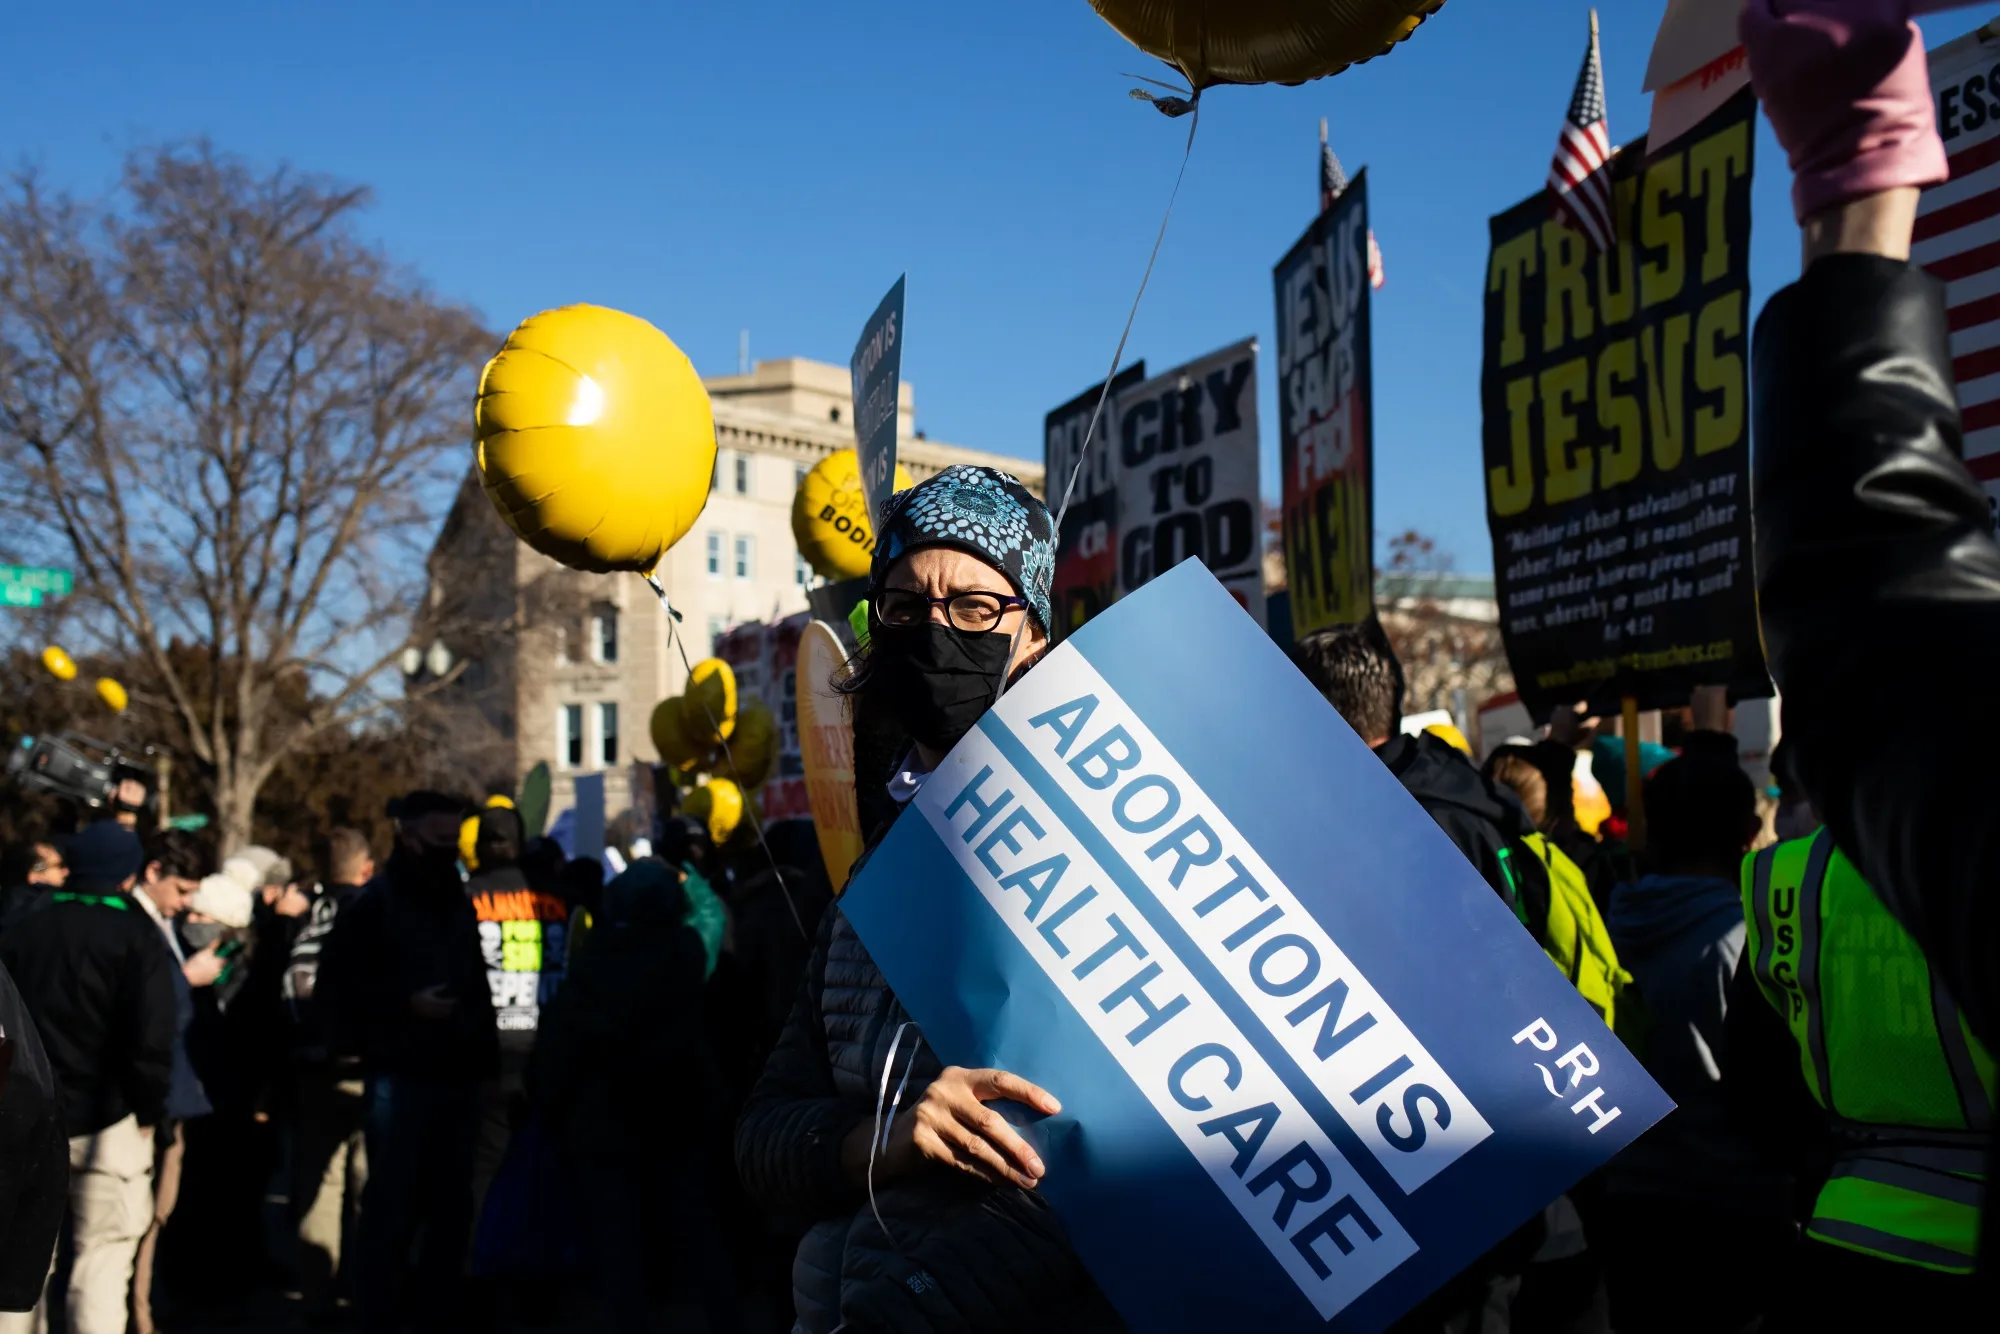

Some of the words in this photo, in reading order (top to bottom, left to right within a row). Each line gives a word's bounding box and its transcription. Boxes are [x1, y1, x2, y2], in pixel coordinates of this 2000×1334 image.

[1281, 201, 1364, 379] JESUS
[1490, 120, 1748, 368] TRUST
[1121, 358, 1253, 469] CRY
[1297, 400, 1353, 491] FRO
[1489, 289, 1745, 516] JESUS
[820, 504, 876, 556] BODI
[1150, 455, 1214, 514] TO
[1121, 498, 1253, 592] GOD
[1671, 576, 1693, 601] be
[1027, 693, 1378, 1063] ABORTION
[1349, 1053, 1452, 1153] IS
[943, 764, 1192, 1045] HEALTH
[1167, 1042, 1383, 1282] CARE
[1511, 1016, 1622, 1135] PRH
[906, 1275, 926, 1294] 850
